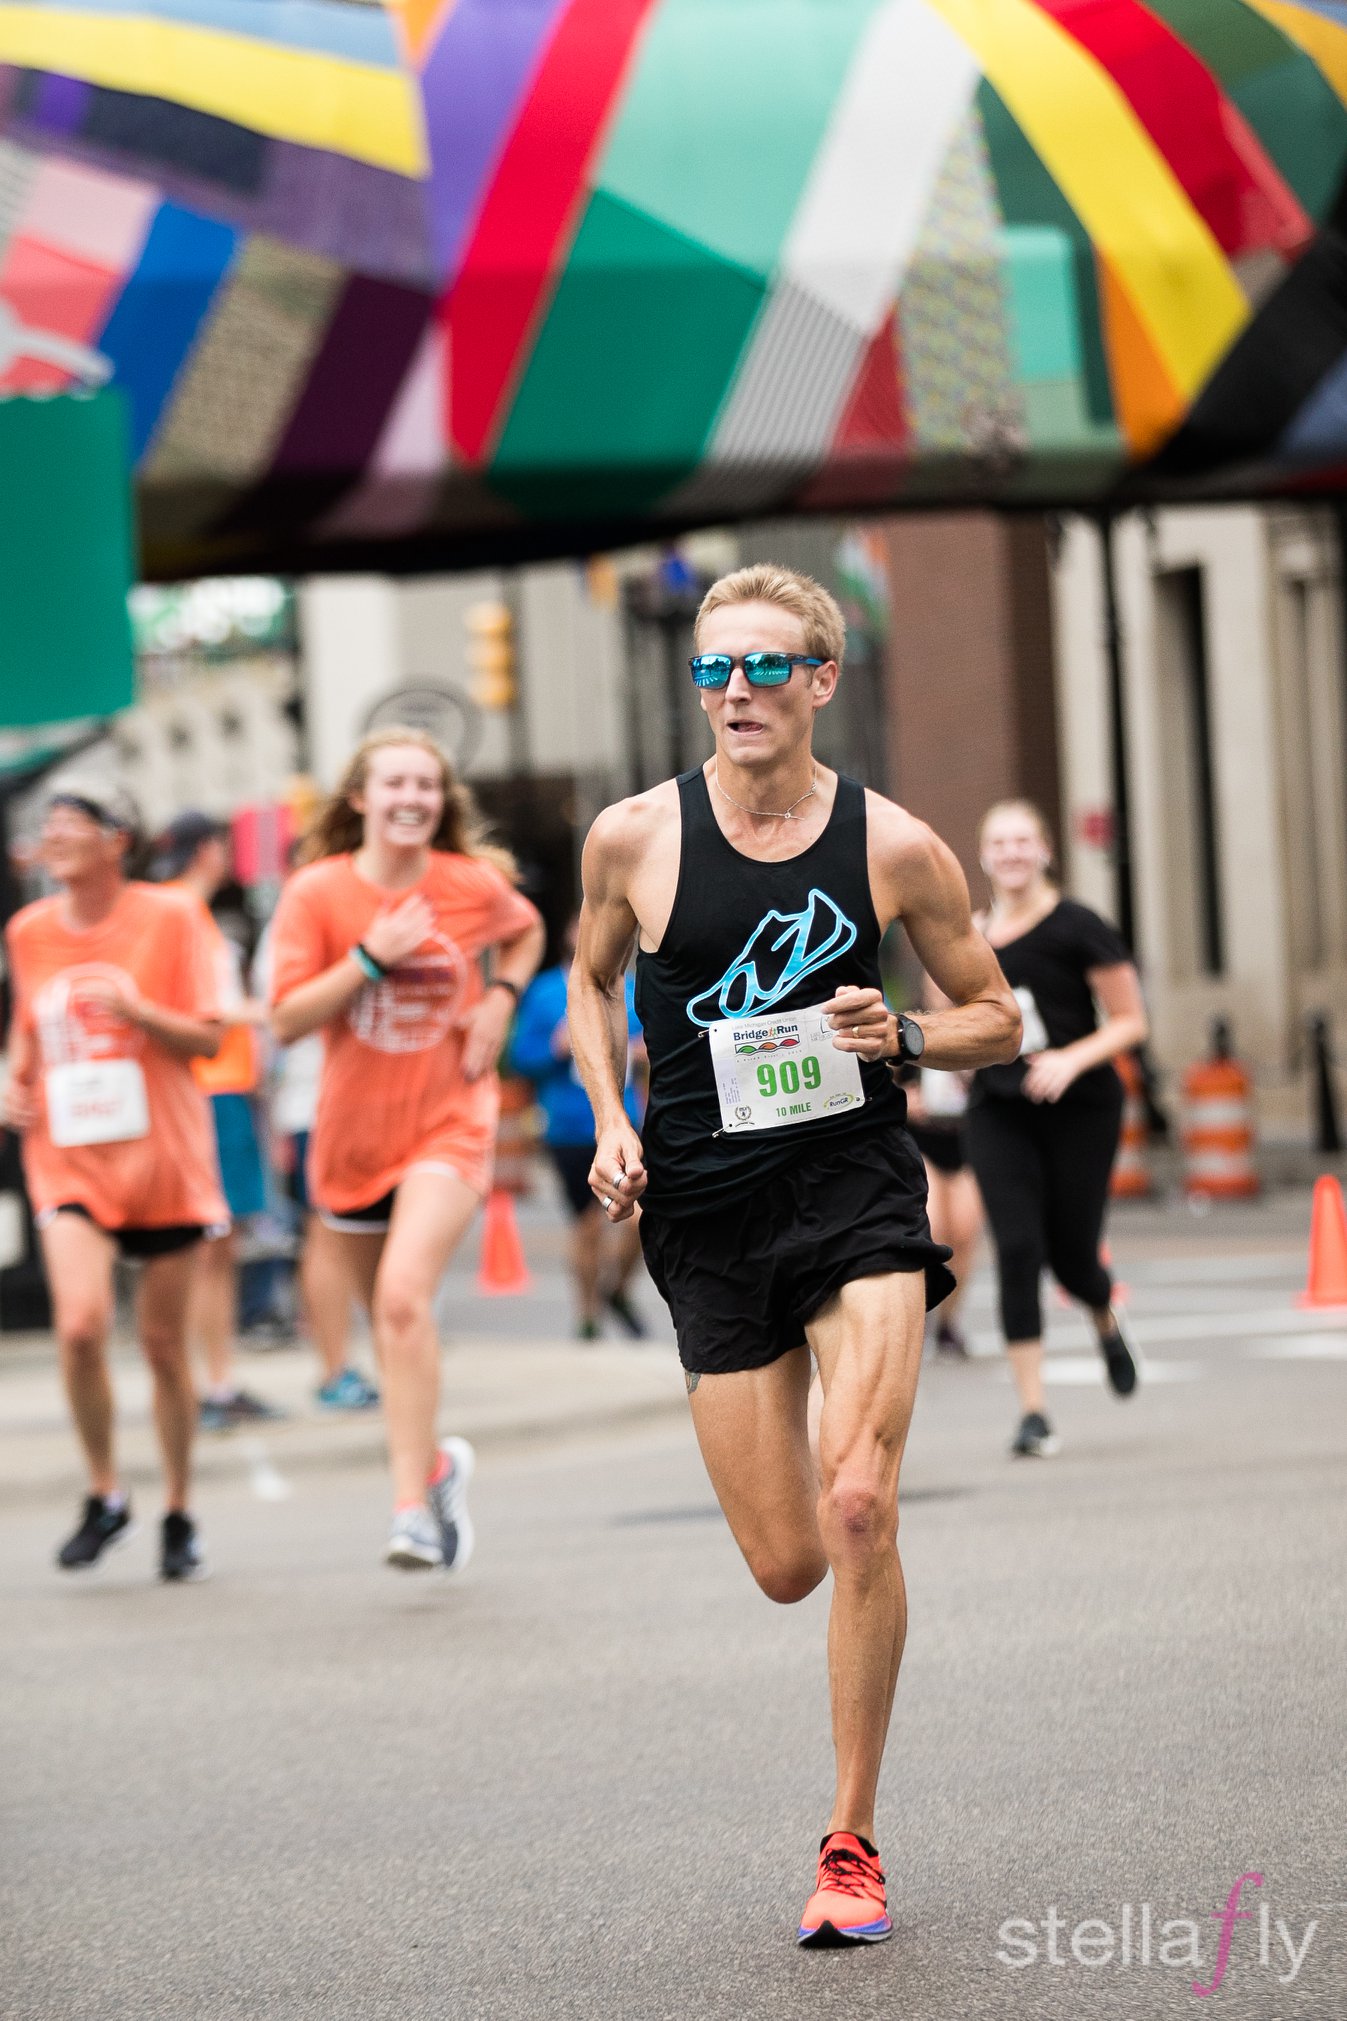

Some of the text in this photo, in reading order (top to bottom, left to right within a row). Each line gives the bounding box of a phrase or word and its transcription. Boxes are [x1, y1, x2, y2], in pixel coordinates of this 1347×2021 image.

[733, 1024, 798, 1041] Bridge Run
[756, 1056, 822, 1097] 909
[775, 1102, 812, 1118] 10 MILE
